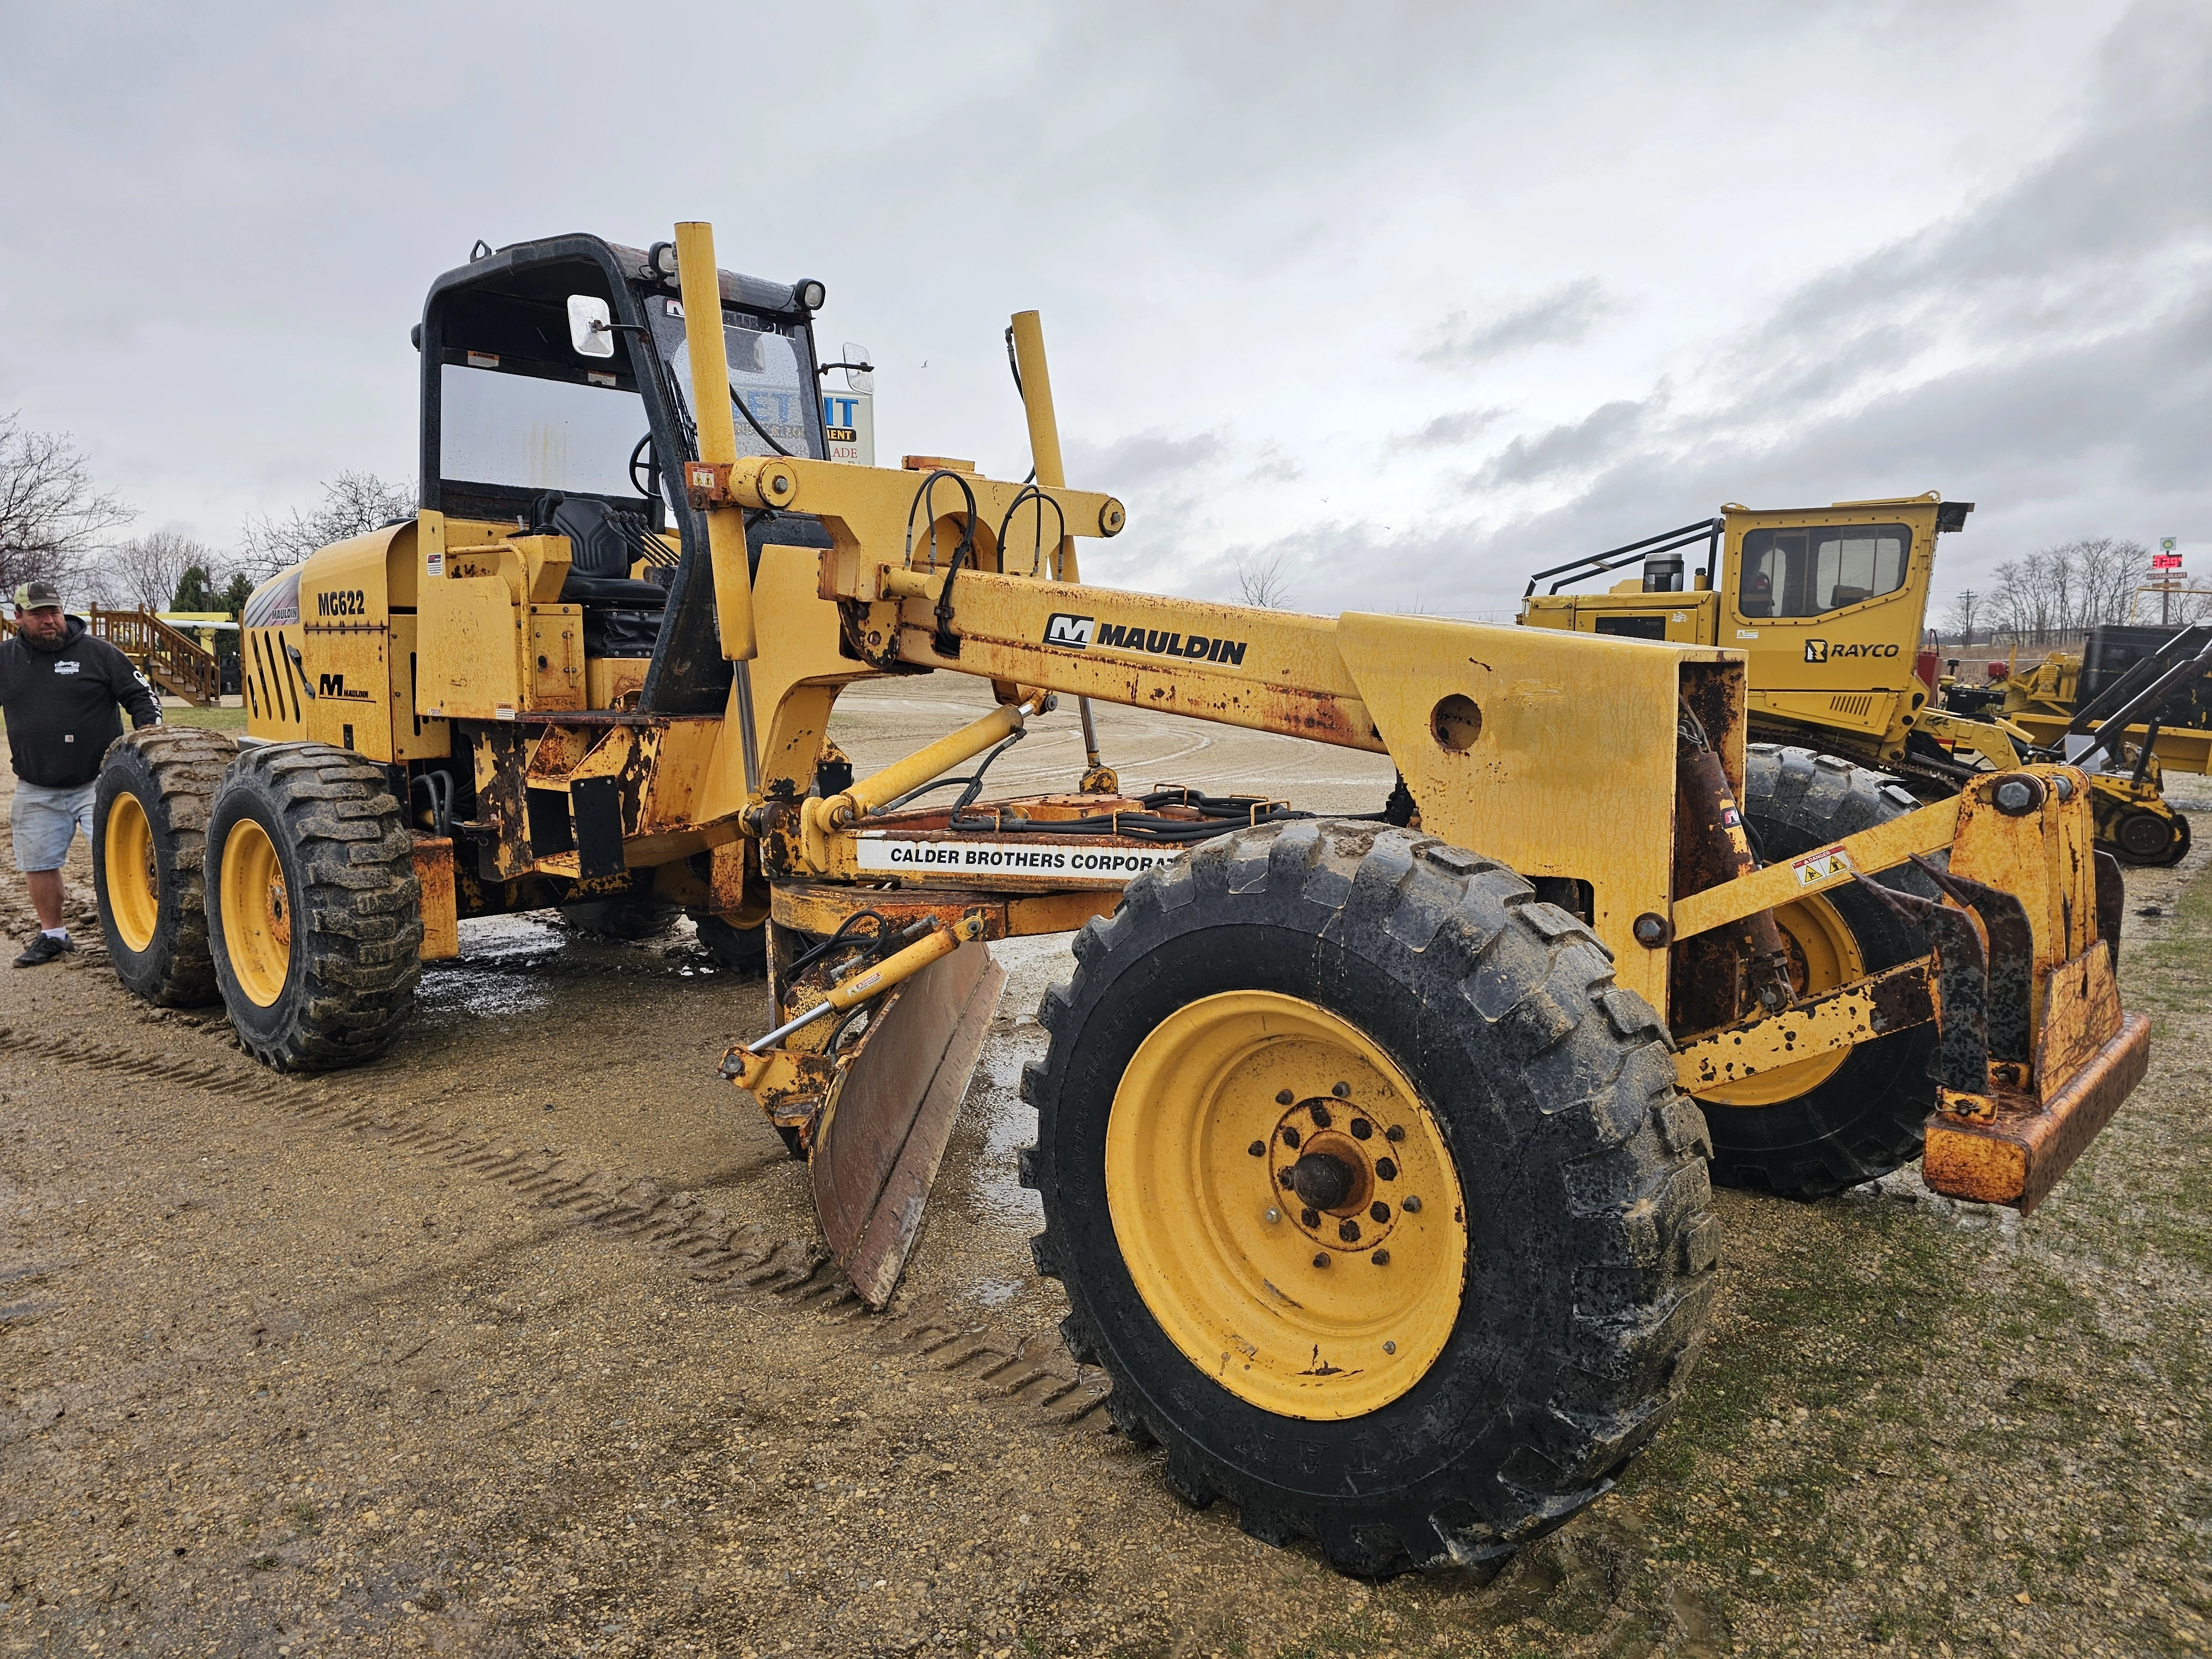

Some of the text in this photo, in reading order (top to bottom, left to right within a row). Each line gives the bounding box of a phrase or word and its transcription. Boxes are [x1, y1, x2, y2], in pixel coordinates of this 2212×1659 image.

[318, 589, 365, 617] MG622
[272, 607, 298, 620] MAULDIN
[1097, 623, 1248, 665] MAULDIN
[1831, 644, 1900, 658] RAYCO
[319, 674, 369, 698] M MAULDIN
[890, 848, 959, 865] CALDER
[965, 851, 1066, 869] BROTHERS
[1808, 851, 1831, 863] DANGER
[861, 974, 879, 985] DANGER
